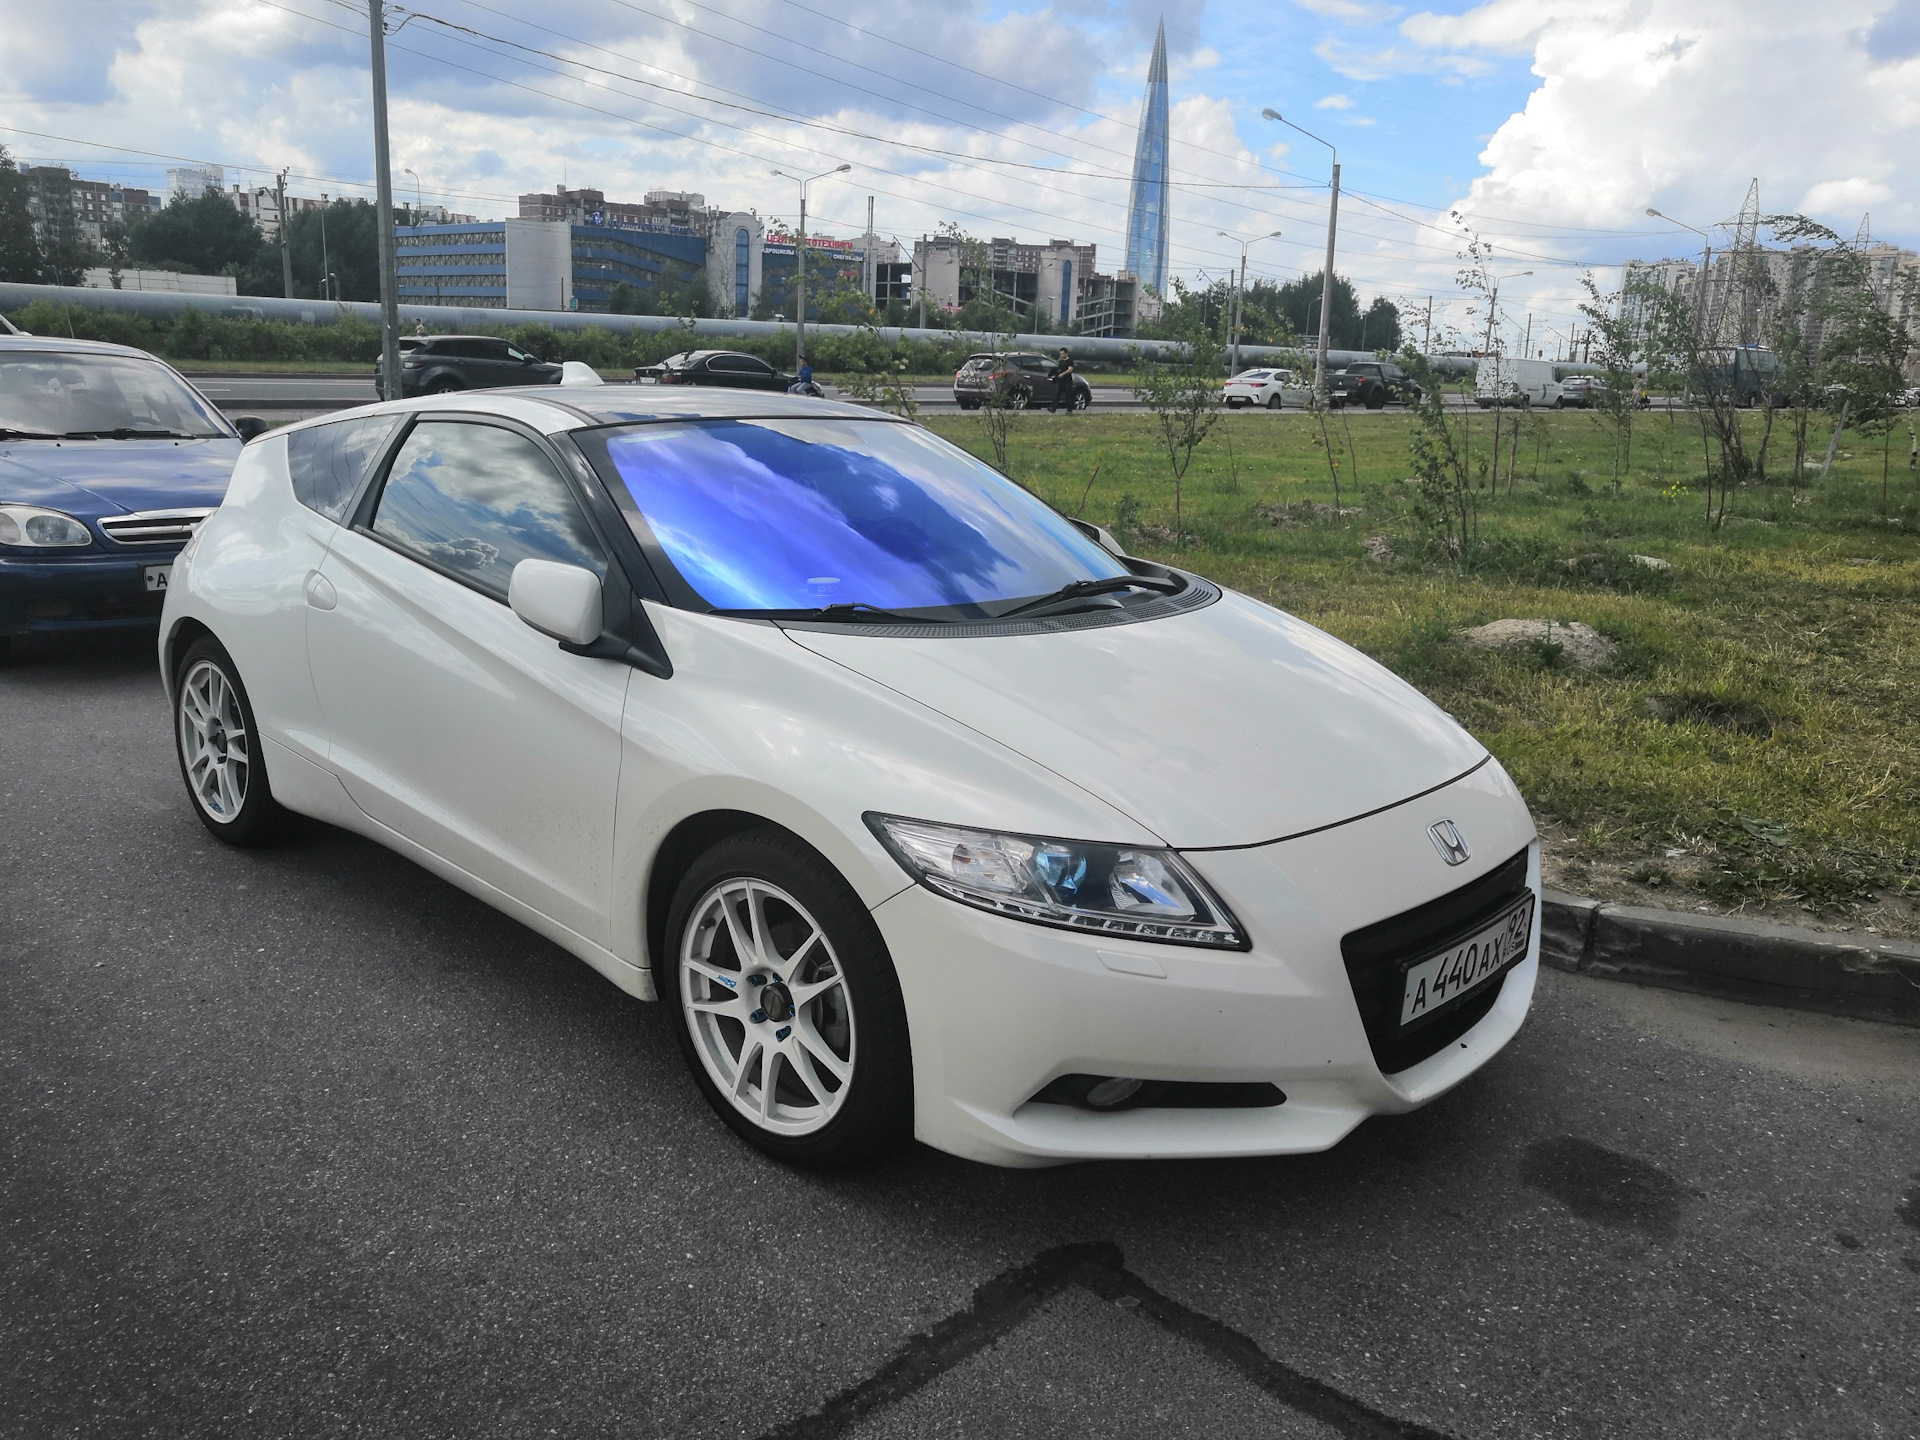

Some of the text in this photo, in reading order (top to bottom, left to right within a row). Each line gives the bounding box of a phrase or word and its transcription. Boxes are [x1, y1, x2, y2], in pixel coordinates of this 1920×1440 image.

[766, 235, 795, 245] ЦЕНТ
[1508, 907, 1526, 944] 92
[1503, 941, 1516, 959] RUS
